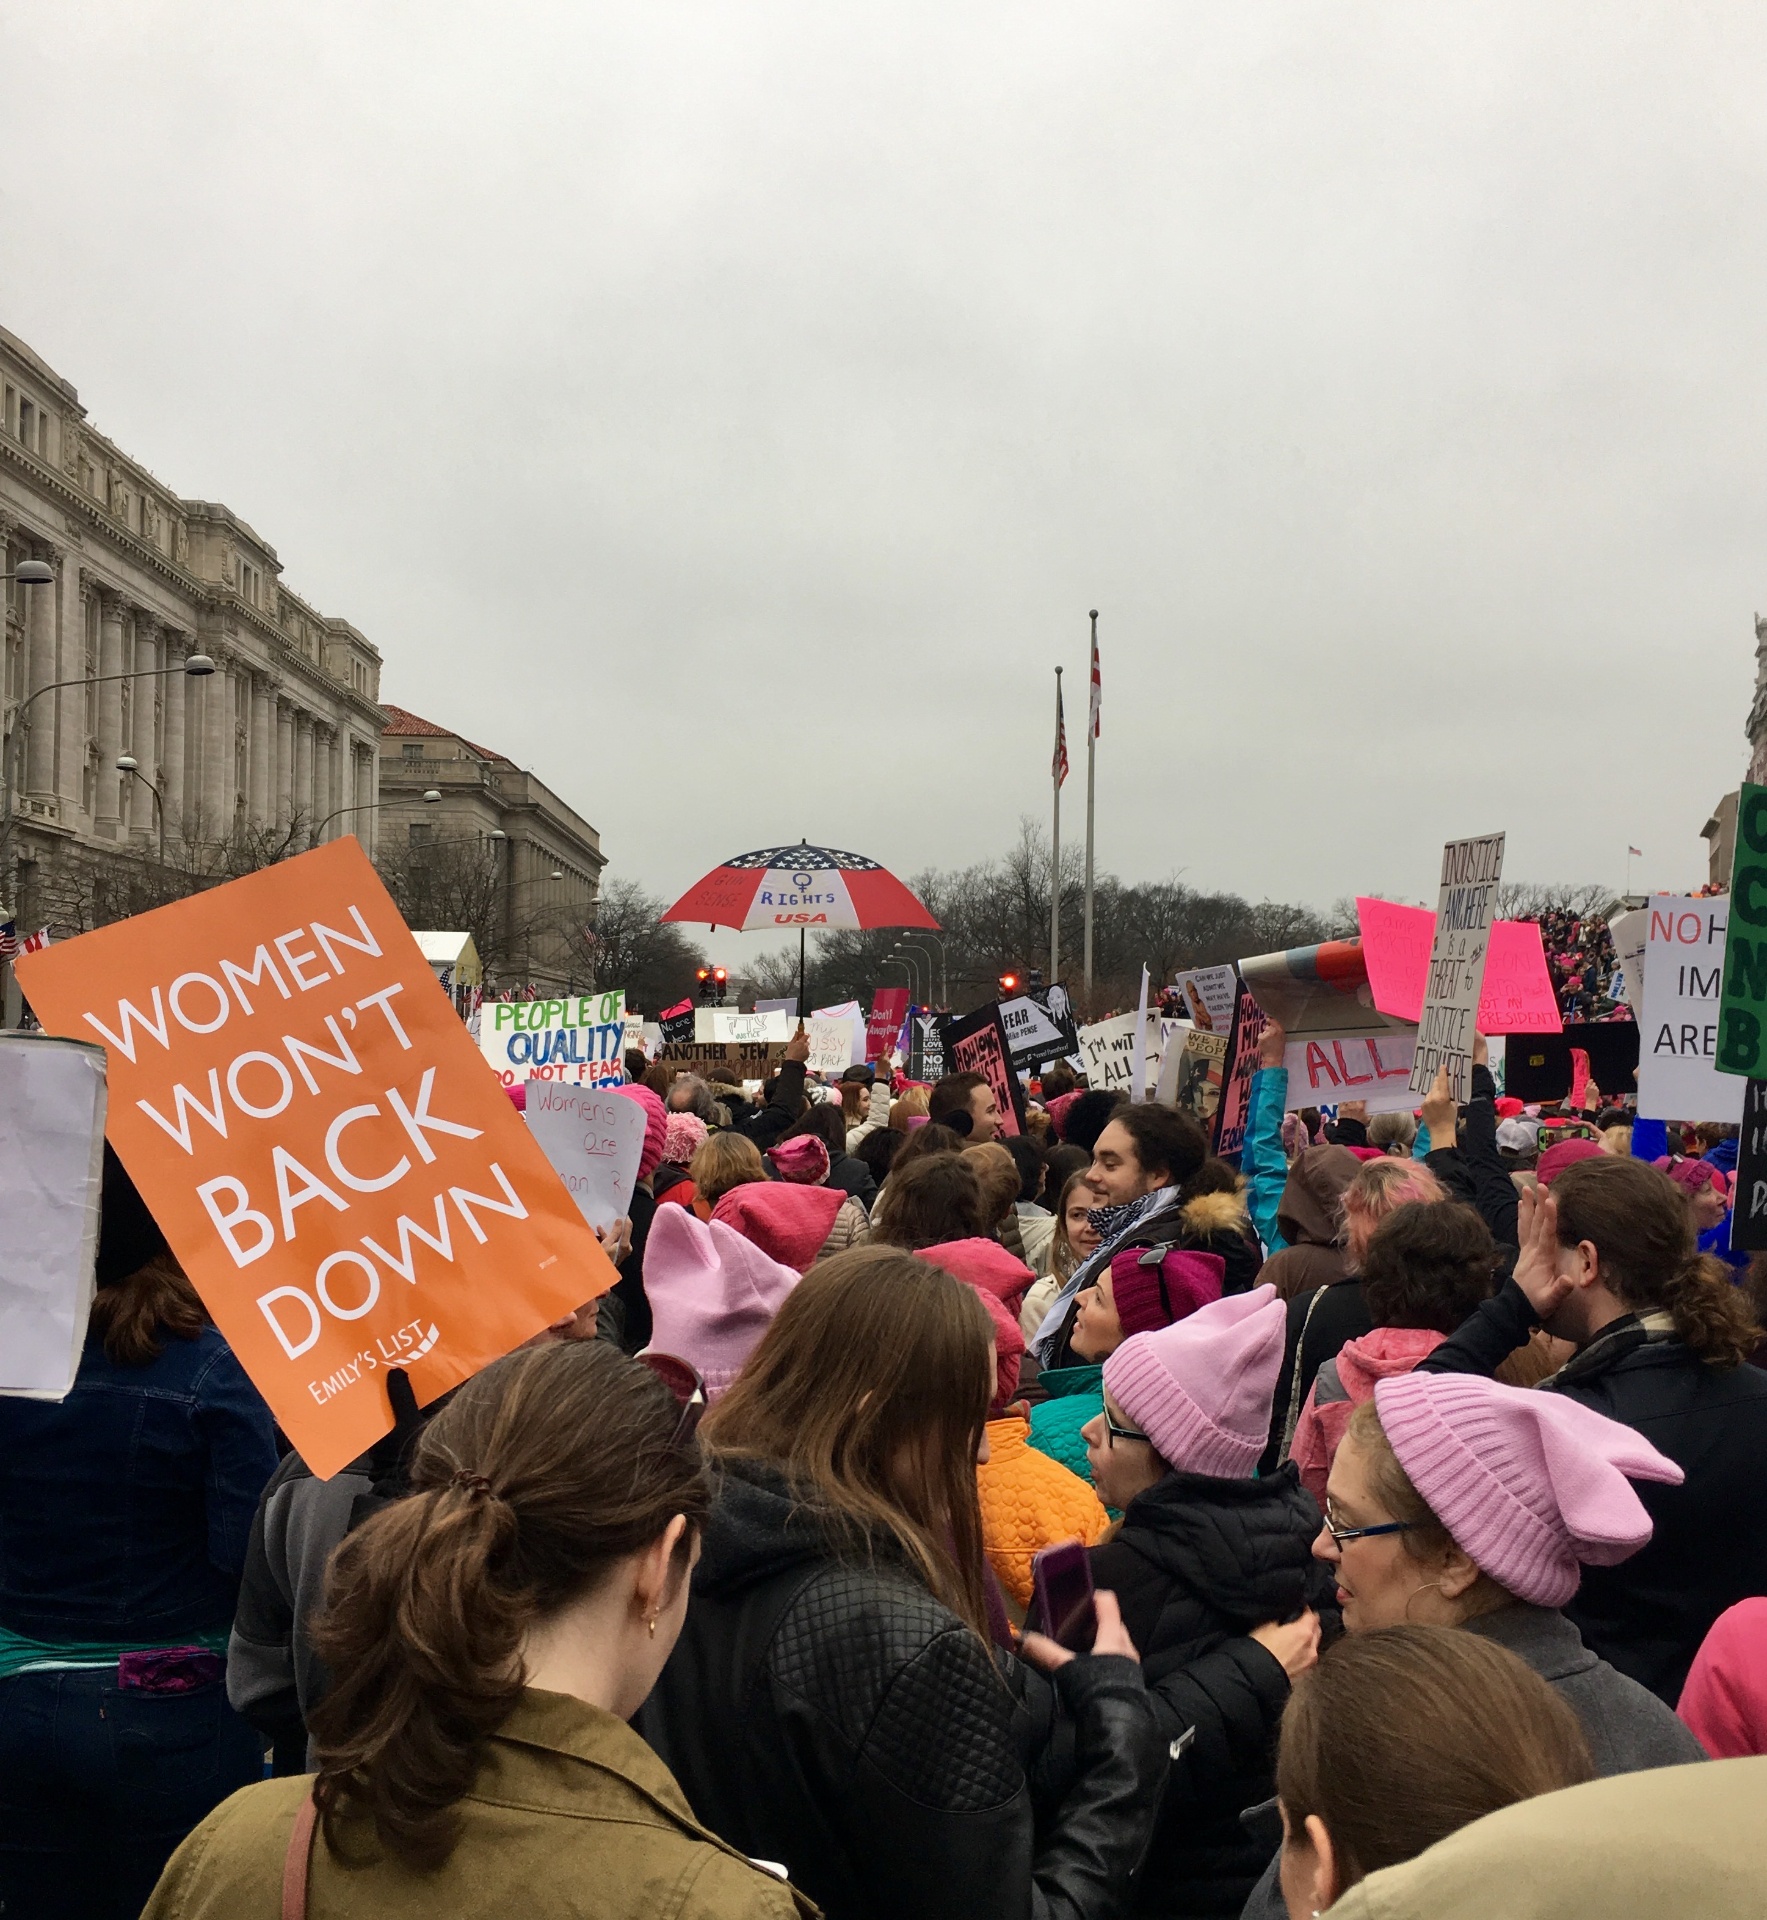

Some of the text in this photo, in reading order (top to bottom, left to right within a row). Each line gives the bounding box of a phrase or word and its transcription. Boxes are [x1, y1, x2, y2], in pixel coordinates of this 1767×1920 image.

[1441, 836, 1504, 887] INJUSTICE
[714, 872, 746, 887] GUN
[695, 890, 743, 908] SENSE
[761, 891, 836, 906] RIGHTS
[774, 912, 828, 925] USA
[1650, 910, 1702, 944] NO
[1370, 930, 1432, 960] PORTLA
[1447, 933, 1466, 957] is a
[82, 905, 383, 1064] WOMEN
[1427, 959, 1466, 1000] THREAT
[1464, 967, 1474, 991] to
[495, 996, 593, 1031] PEOPLE
[600, 990, 625, 1024] OF
[1507, 996, 1523, 1010] MY
[660, 1021, 674, 1034] No
[675, 1017, 690, 1028] one
[1003, 1008, 1030, 1030] FEAR
[1020, 1024, 1039, 1037] PENSE
[1421, 1005, 1471, 1051] JUSTICE
[506, 1021, 625, 1066] QUALITY
[661, 1044, 727, 1061] ANOTHER
[739, 1043, 770, 1061] JEW
[808, 1037, 846, 1052] USSY
[1087, 1036, 1107, 1066] I'M
[1111, 1032, 1136, 1052] WIT
[1188, 1032, 1211, 1044] WE
[1653, 1023, 1717, 1056] ARE
[136, 983, 412, 1155] WON'T
[530, 1064, 568, 1081] NOT
[578, 1057, 624, 1081] FEAR
[820, 1054, 845, 1067] BACK
[923, 1054, 944, 1065] NO
[1104, 1056, 1134, 1087] ALL
[1305, 1038, 1412, 1088] ALL
[536, 1083, 617, 1126] Womens
[196, 1067, 484, 1268] BACK
[256, 1163, 529, 1361] DOWN
[307, 1318, 424, 1405] EMILY'S LIST
